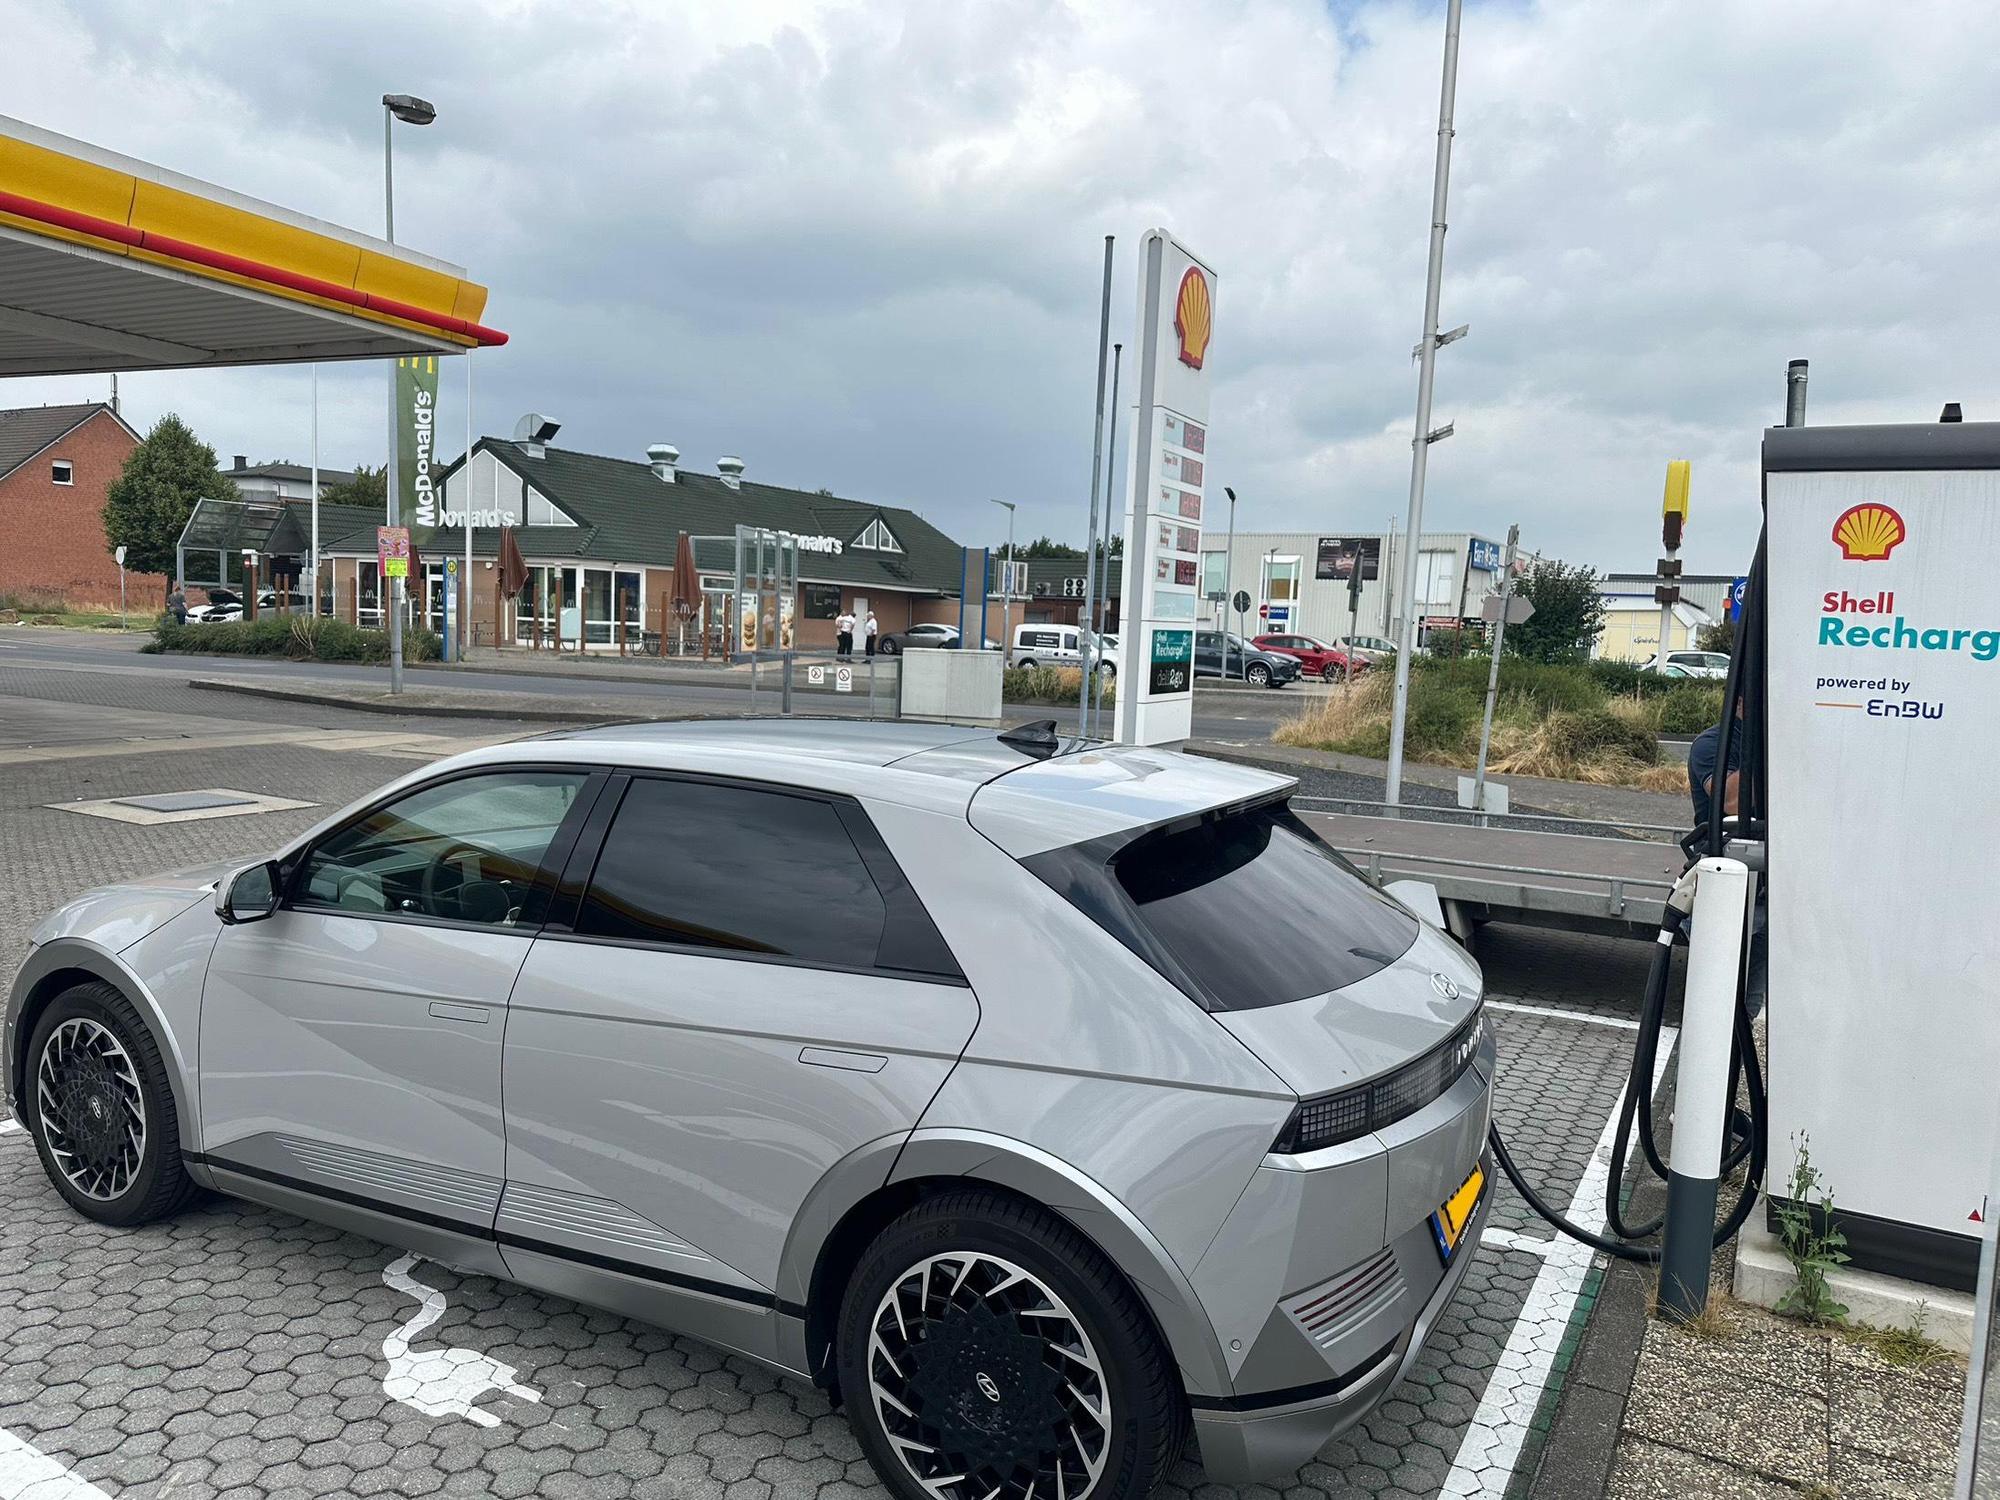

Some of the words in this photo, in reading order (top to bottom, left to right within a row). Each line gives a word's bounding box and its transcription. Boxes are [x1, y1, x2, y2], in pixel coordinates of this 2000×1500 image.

[415, 391, 434, 527] McDonald's
[1822, 591, 1894, 614] Shell
[1818, 617, 2000, 661] Recharg
[1155, 643, 1184, 660] Recharge
[1816, 677, 1886, 690] powered
[1891, 678, 1911, 694] by
[1867, 699, 1944, 719] EnBW
